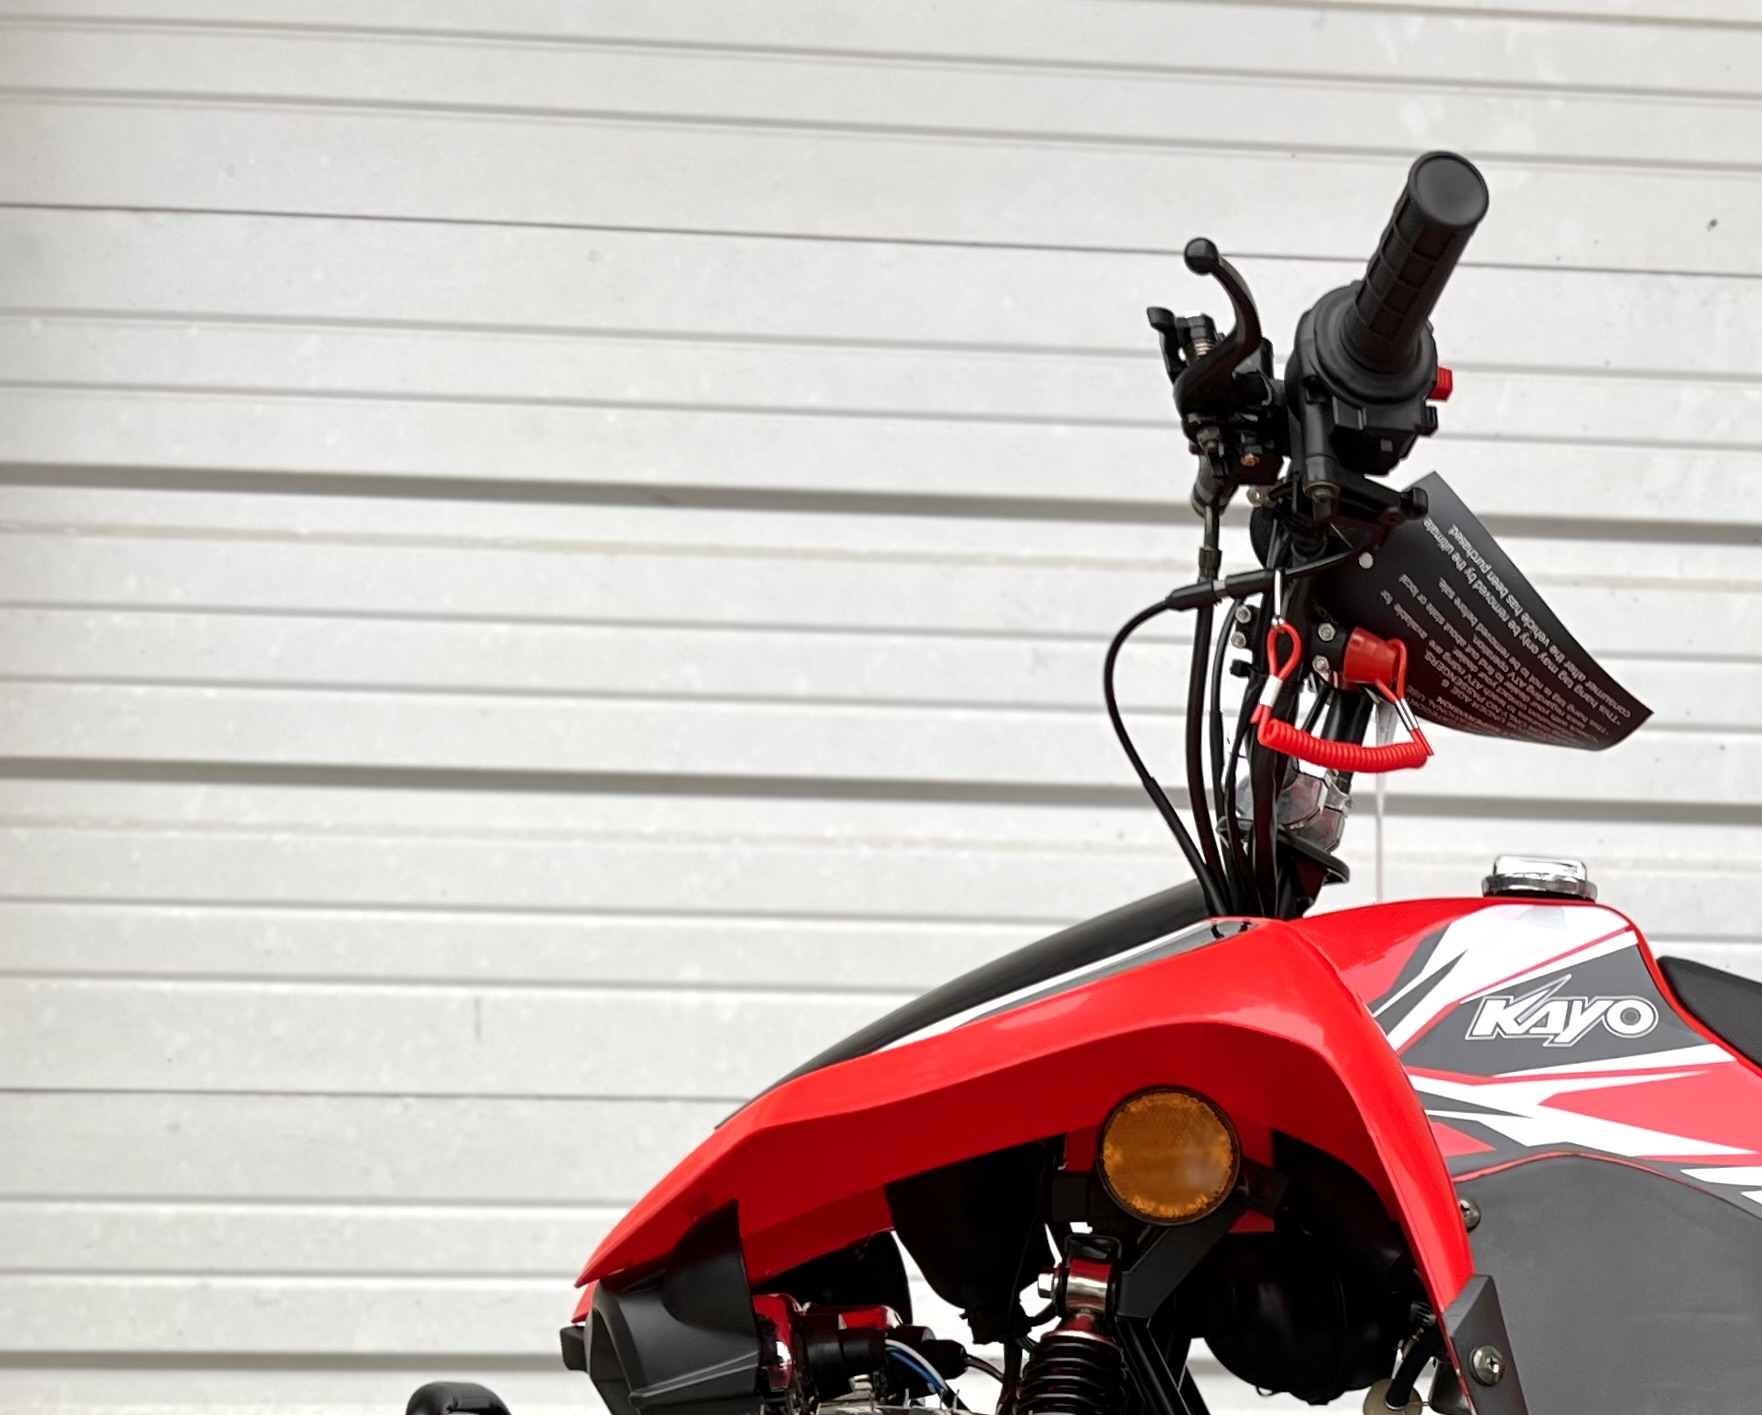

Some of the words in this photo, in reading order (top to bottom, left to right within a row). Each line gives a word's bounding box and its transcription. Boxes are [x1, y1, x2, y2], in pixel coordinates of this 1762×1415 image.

[1422, 517, 1454, 554] ultimate
[1451, 552, 1465, 570] the
[1463, 565, 1476, 583] by
[1398, 573, 1419, 596] local
[1485, 571, 1508, 597] been
[1379, 588, 1393, 604] for
[1417, 593, 1427, 604] or
[1471, 579, 1509, 622] removed
[1505, 594, 1523, 616] has
[1424, 603, 1445, 623] state
[1453, 596, 1478, 626] before
[1392, 603, 1428, 639] available
[1507, 619, 1520, 636] be
[1519, 612, 1550, 646] vehicle
[1443, 622, 1466, 646] about
[1474, 622, 1509, 658] removed
[1518, 632, 1539, 654] only
[1427, 638, 1443, 654] are
[1464, 644, 1479, 659] out
[1548, 645, 1565, 662] the
[1477, 658, 1494, 674] find
[1508, 656, 1520, 669] be
[1519, 666, 1529, 676] to
[1538, 651, 1559, 673] may
[1477, 670, 1496, 687] your
[1494, 671, 1504, 681] to
[1507, 671, 1526, 687] ATV
[1557, 669, 1574, 688] tag
[1562, 660, 1586, 683] after
[1440, 679, 1449, 688] 6
[1464, 672, 1483, 690] ATV
[1529, 675, 1543, 688] not
[1450, 686, 1473, 704] AGE
[1503, 680, 1530, 702] dealer
[1542, 687, 1552, 695] is
[1551, 692, 1566, 706] tag
[1573, 683, 1598, 708] hang
[1585, 680, 1630, 717] consumer
[1472, 701, 1505, 723] UNDER
[1530, 699, 1550, 716] your
[1566, 704, 1588, 722] hang
[1465, 974, 1659, 1047] KAYO
